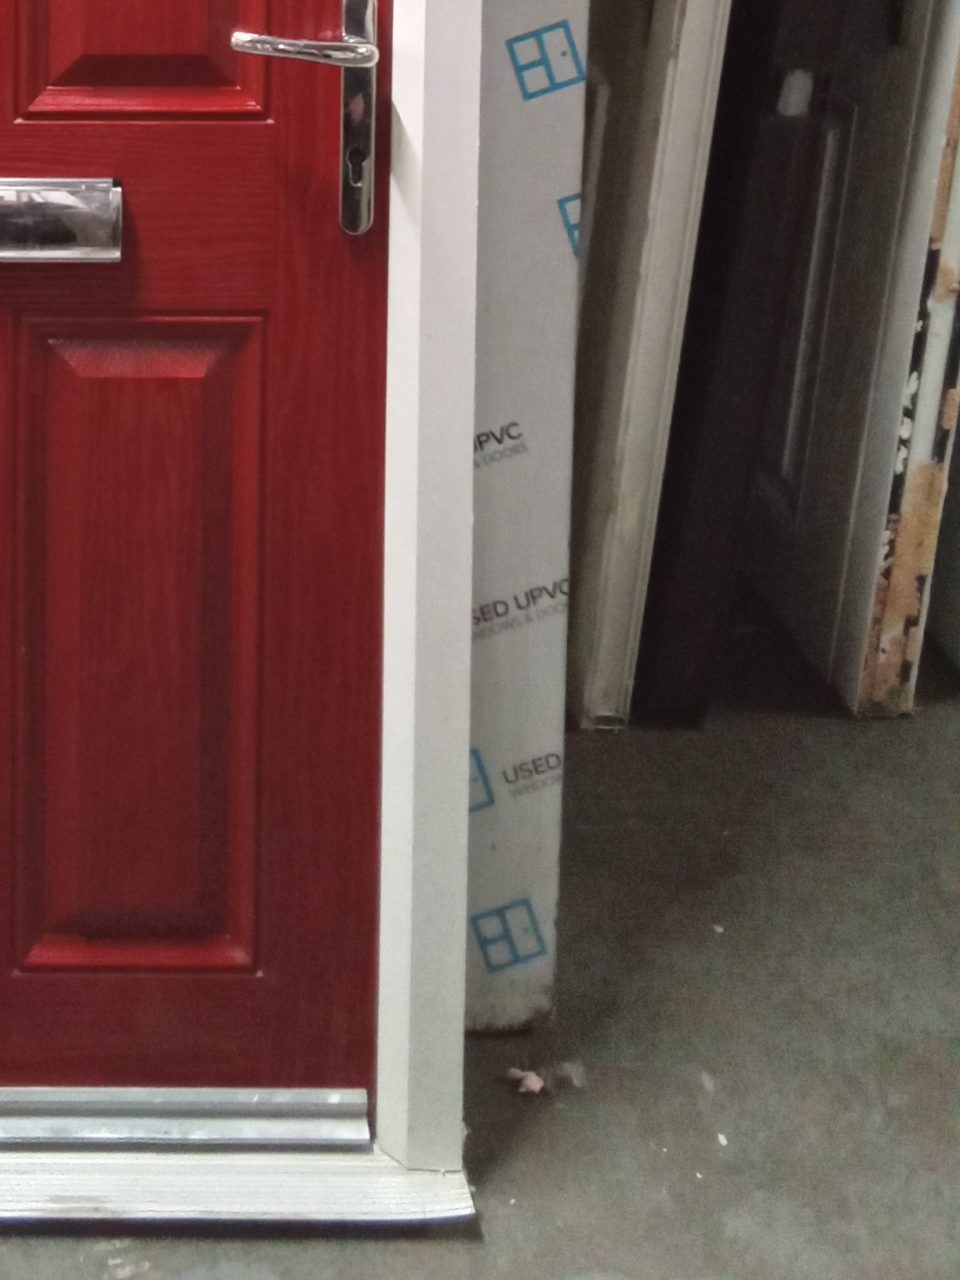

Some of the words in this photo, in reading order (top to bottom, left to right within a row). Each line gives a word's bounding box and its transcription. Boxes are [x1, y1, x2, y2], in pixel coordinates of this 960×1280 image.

[474, 422, 523, 452] PVC
[472, 600, 509, 626] SED
[502, 753, 562, 785] USED
